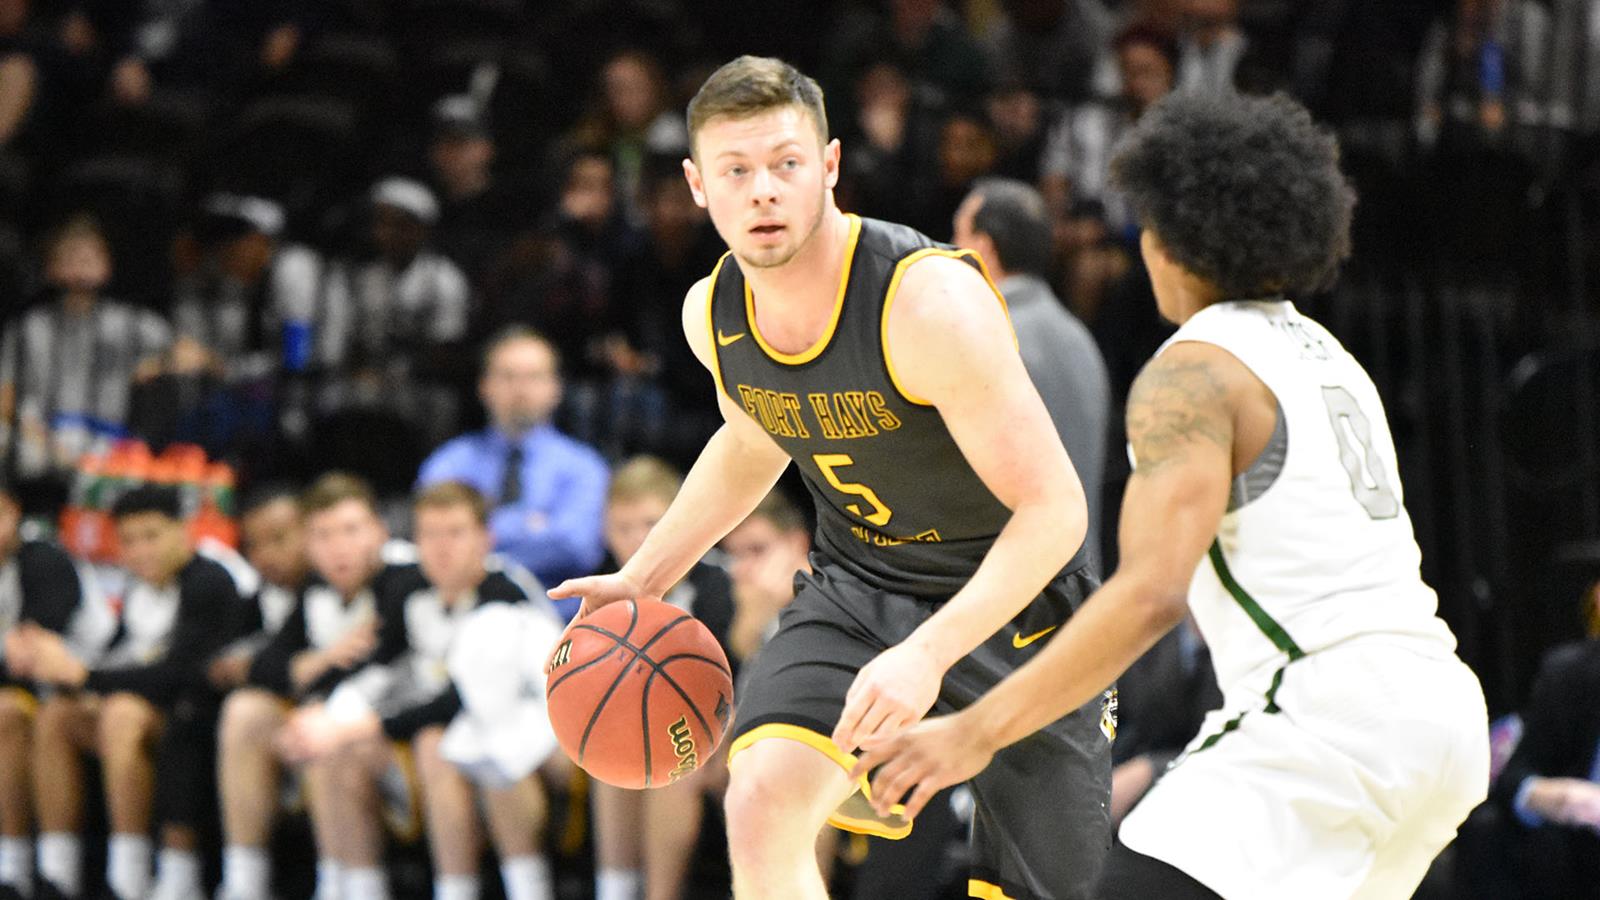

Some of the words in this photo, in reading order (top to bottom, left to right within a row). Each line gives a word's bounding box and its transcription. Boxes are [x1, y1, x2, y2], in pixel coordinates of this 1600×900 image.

[737, 384, 810, 438] FORT
[808, 391, 901, 438] HAYS
[1321, 385, 1399, 520] 0
[812, 454, 892, 526] 5
